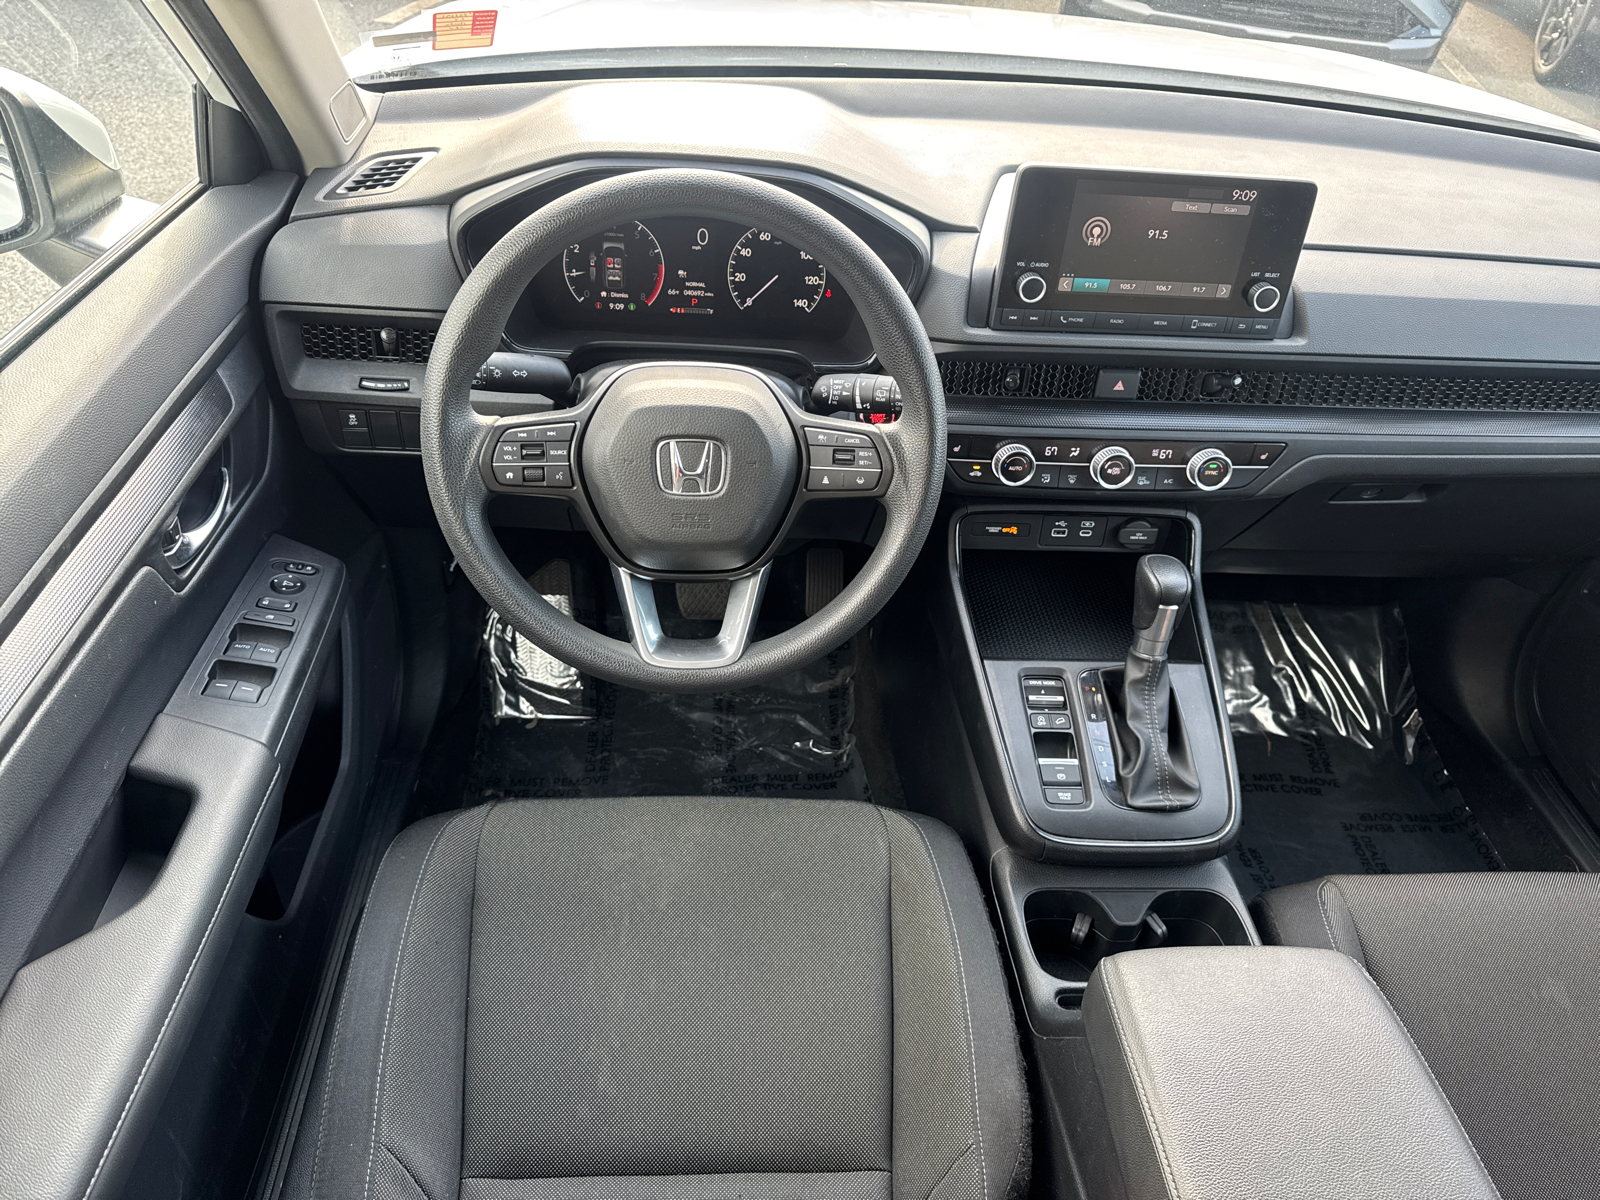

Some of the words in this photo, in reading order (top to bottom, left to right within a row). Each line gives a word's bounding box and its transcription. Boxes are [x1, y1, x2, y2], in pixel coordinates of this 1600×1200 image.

[1232, 189, 1258, 202] 9:09
[697, 228, 709, 245] 0
[759, 231, 771, 241] 60
[1147, 229, 1169, 240] 91.5
[1087, 237, 1101, 247] FM
[573, 244, 580, 253] 2
[740, 248, 752, 257] 40
[799, 251, 814, 260] 10
[734, 272, 746, 282] 20
[804, 276, 819, 285] 120
[683, 289, 705, 297] 040692
[1155, 284, 1173, 292] 106.7
[608, 302, 625, 310] 9:09
[691, 298, 698, 306] P
[793, 298, 808, 307] 140
[1044, 446, 1058, 456] 67
[1159, 449, 1173, 459] 67
[258, 646, 275, 654] AUTO
[585, 730, 599, 773] DEALER
[767, 773, 799, 783] MUST
[807, 761, 856, 782] REMOVE
[510, 777, 545, 788] MUST
[553, 774, 609, 788] REMOVE
[1252, 772, 1285, 783] MUST
[1288, 774, 1342, 789] REMOVE
[712, 783, 788, 795] PROTECTIVE
[791, 781, 838, 791] COVER
[1280, 784, 1324, 797] COVER
[1341, 822, 1395, 834] REMOVE
[1401, 822, 1433, 834] MUST
[1438, 814, 1478, 834] EALER
